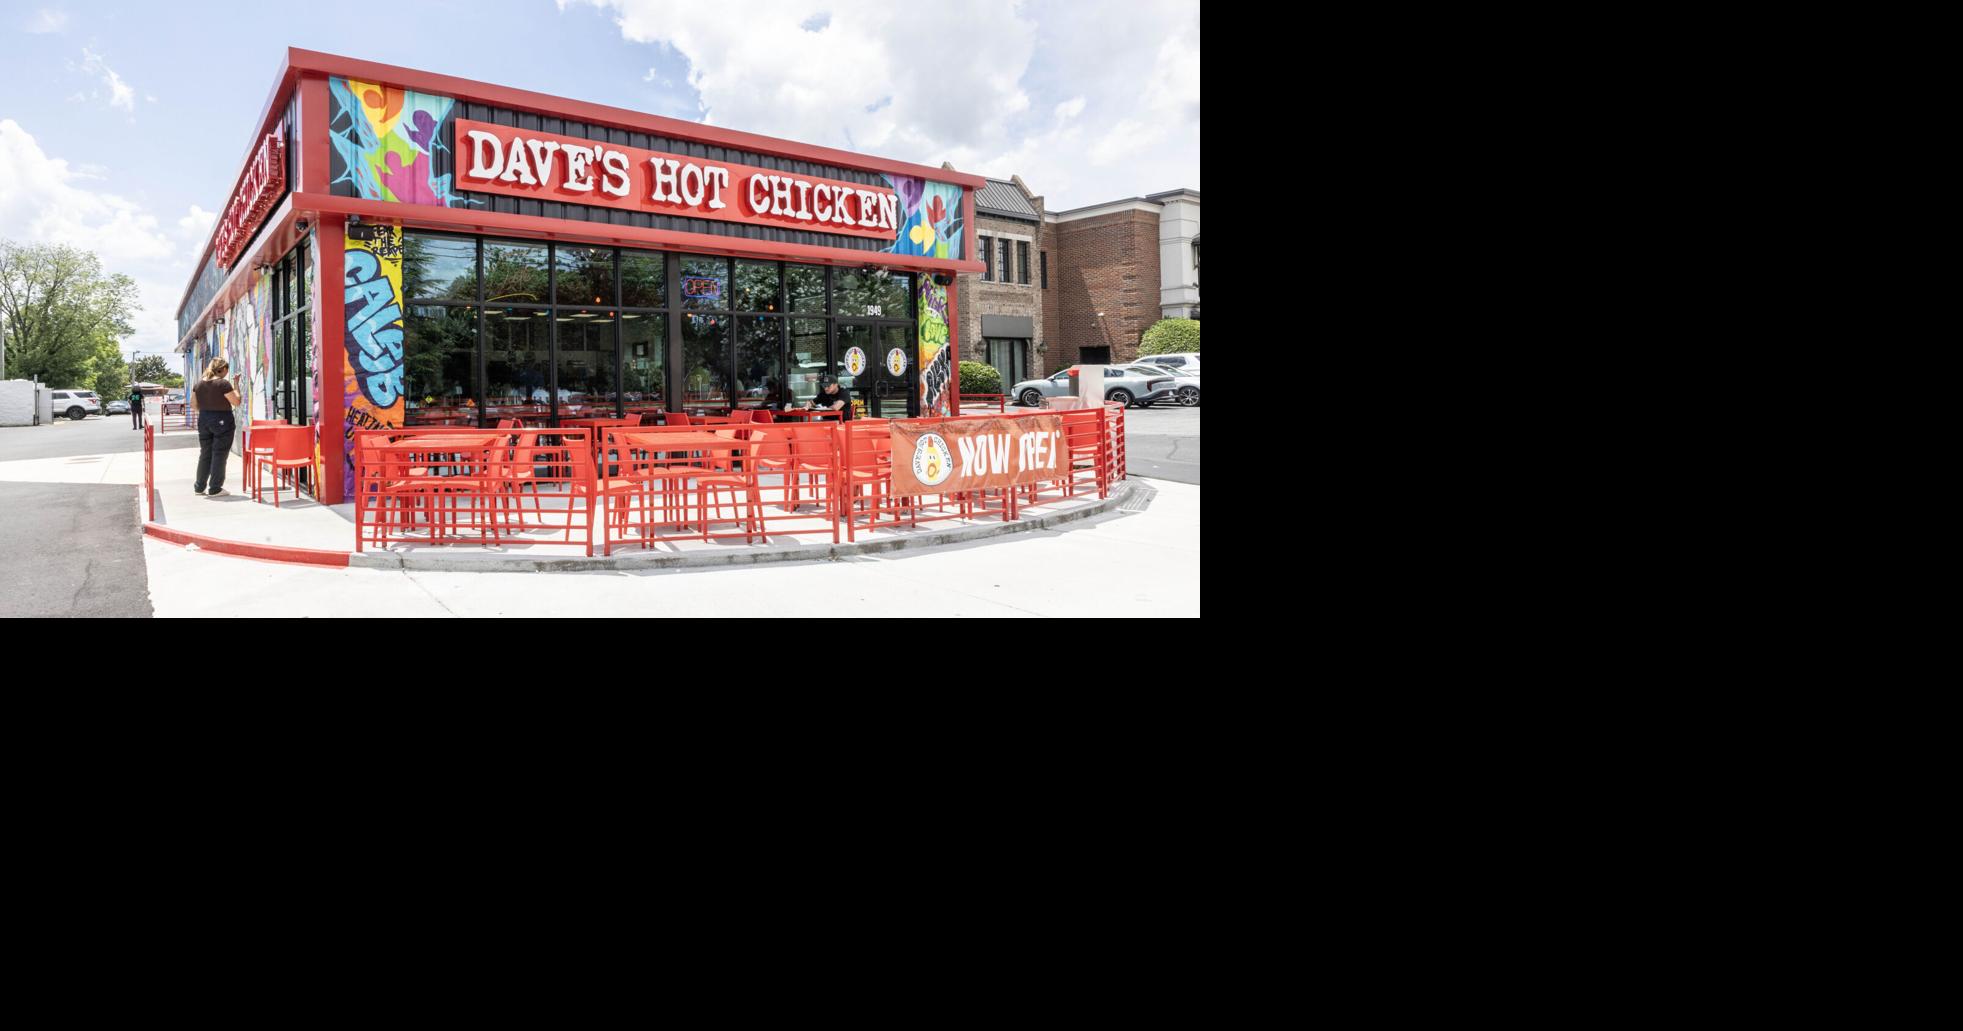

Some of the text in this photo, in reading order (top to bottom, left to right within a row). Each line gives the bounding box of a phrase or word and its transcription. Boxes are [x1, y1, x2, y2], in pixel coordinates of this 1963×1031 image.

[468, 130, 898, 230] DAVE'S HOT CHICKEN
[867, 305, 882, 316] 1949
[957, 433, 1011, 478] NOW
